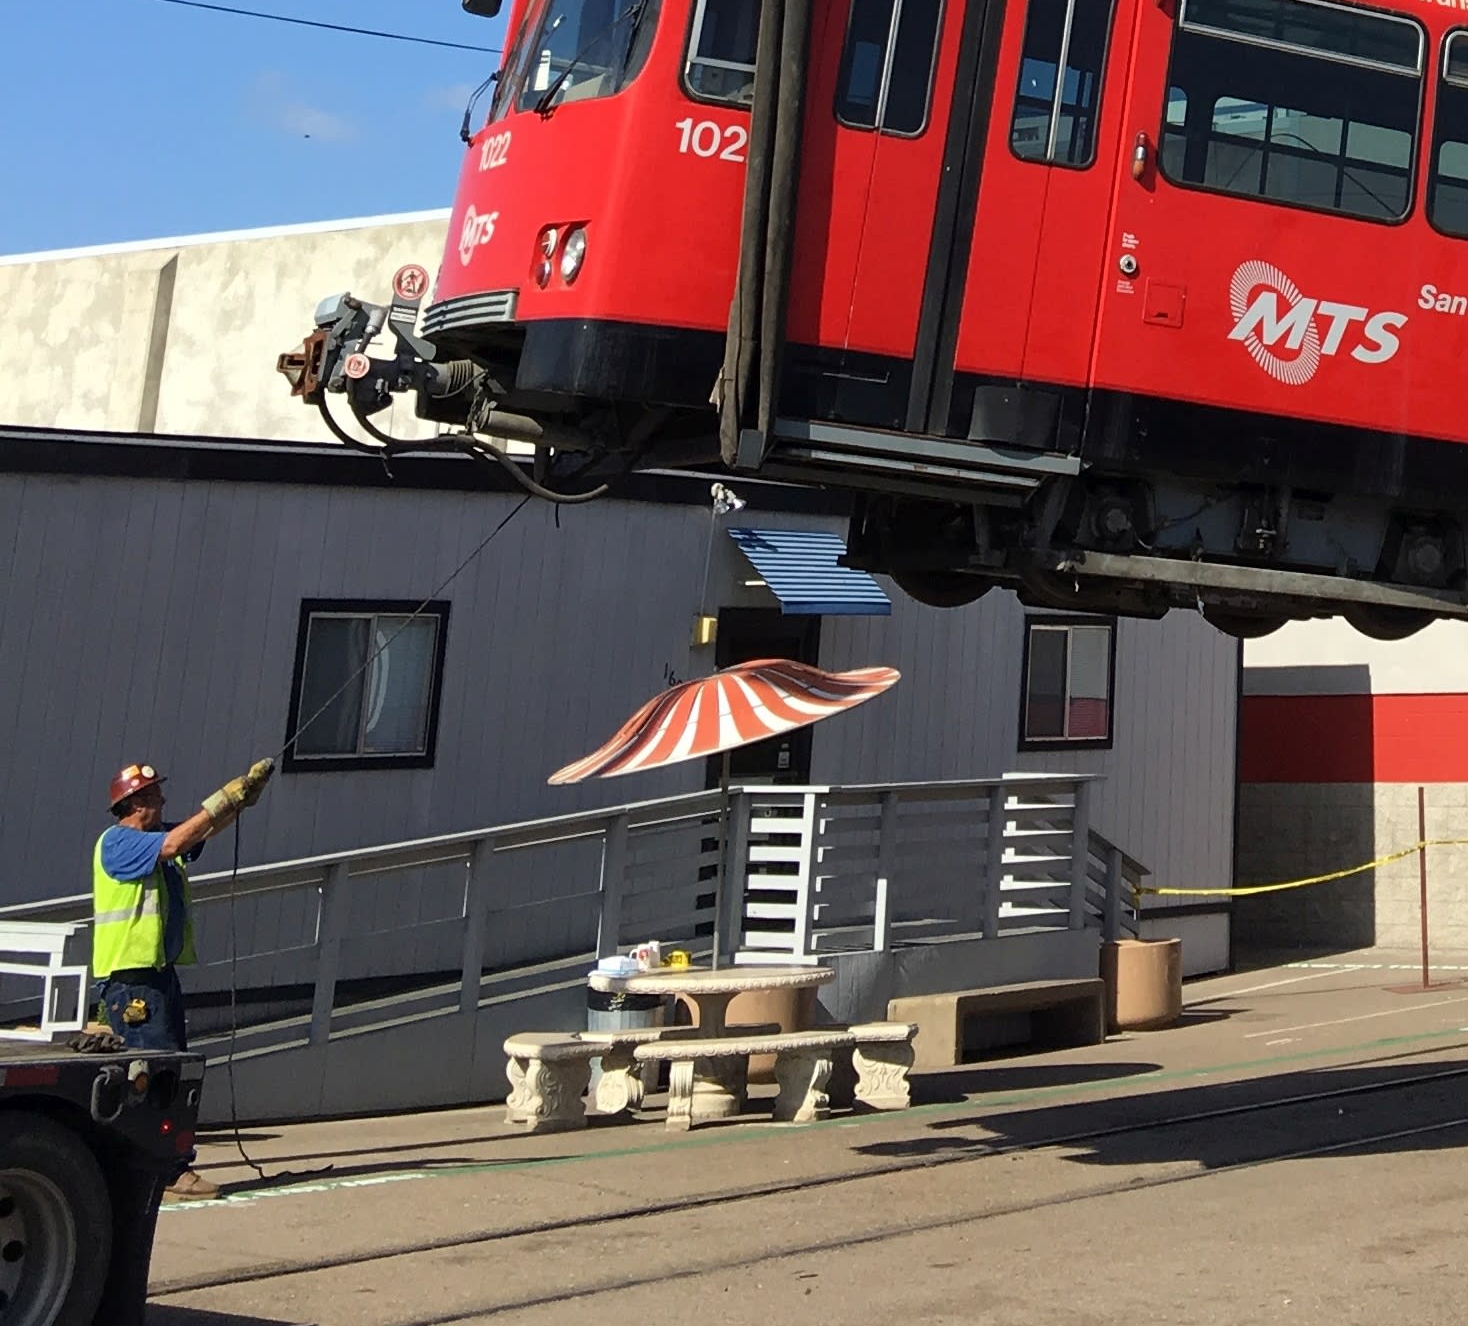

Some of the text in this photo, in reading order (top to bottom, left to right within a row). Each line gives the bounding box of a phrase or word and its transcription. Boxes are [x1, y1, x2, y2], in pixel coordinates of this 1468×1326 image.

[478, 130, 512, 172] 1022
[675, 117, 750, 164] 102
[458, 209, 499, 253] MTS
[1416, 284, 1468, 316] San
[1227, 290, 1409, 364] MTS
